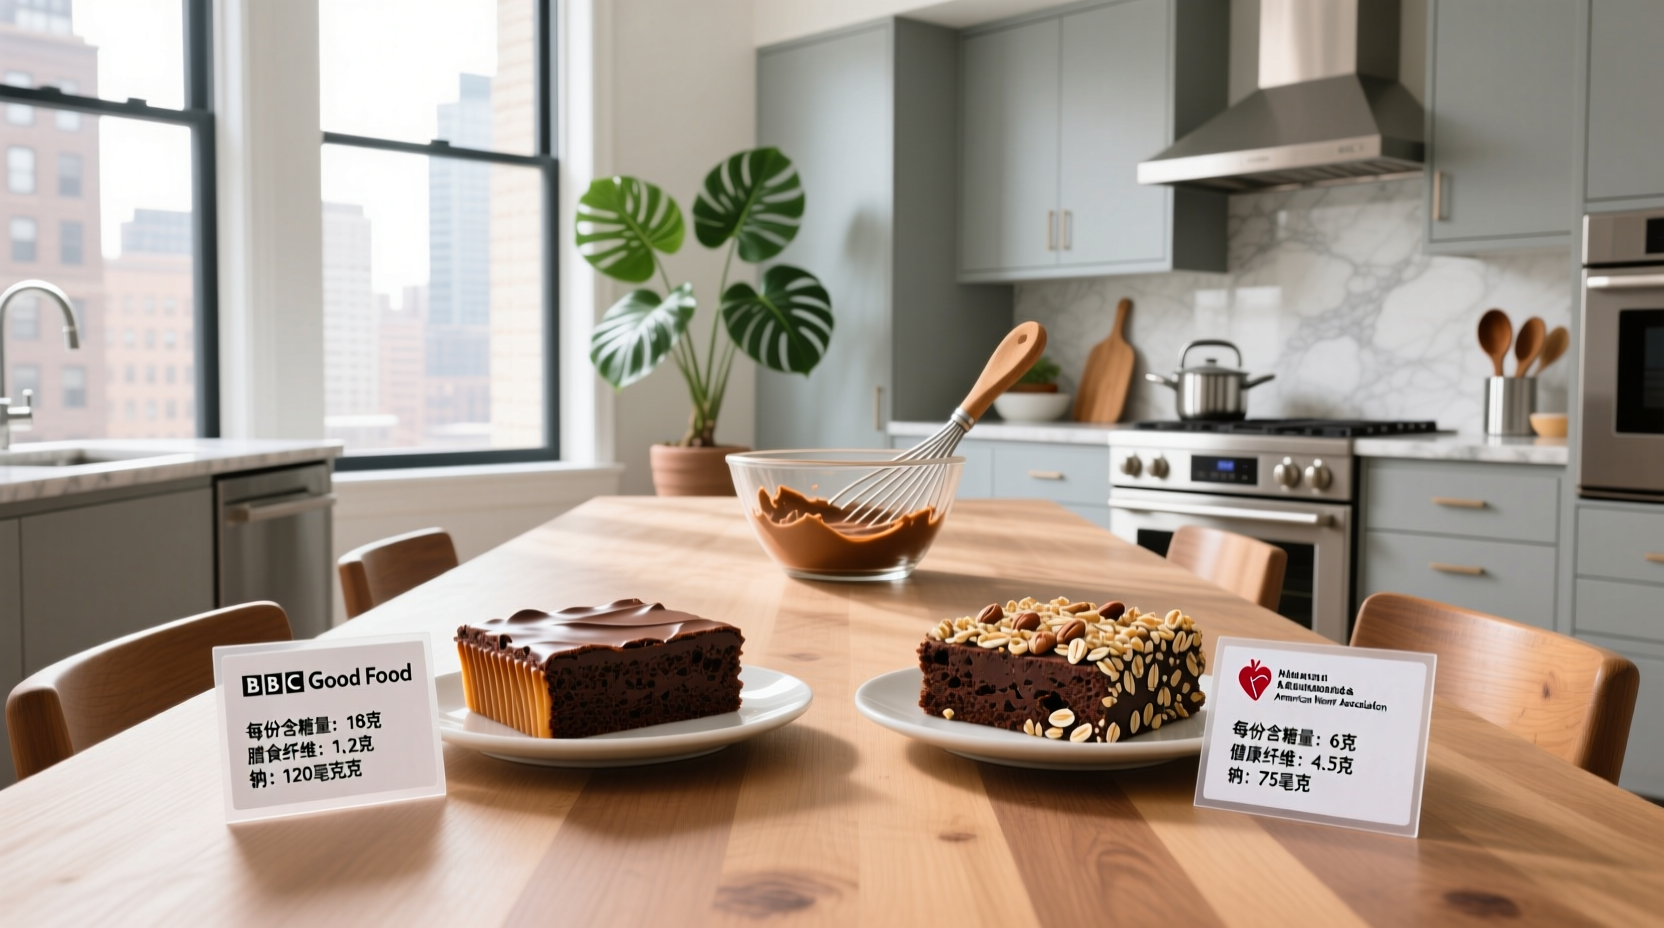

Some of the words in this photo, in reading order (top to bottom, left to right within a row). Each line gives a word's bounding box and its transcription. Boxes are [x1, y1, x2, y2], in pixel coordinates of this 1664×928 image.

[243, 672, 303, 696] BBC
[308, 668, 361, 690] Good
[365, 663, 412, 685] Food
